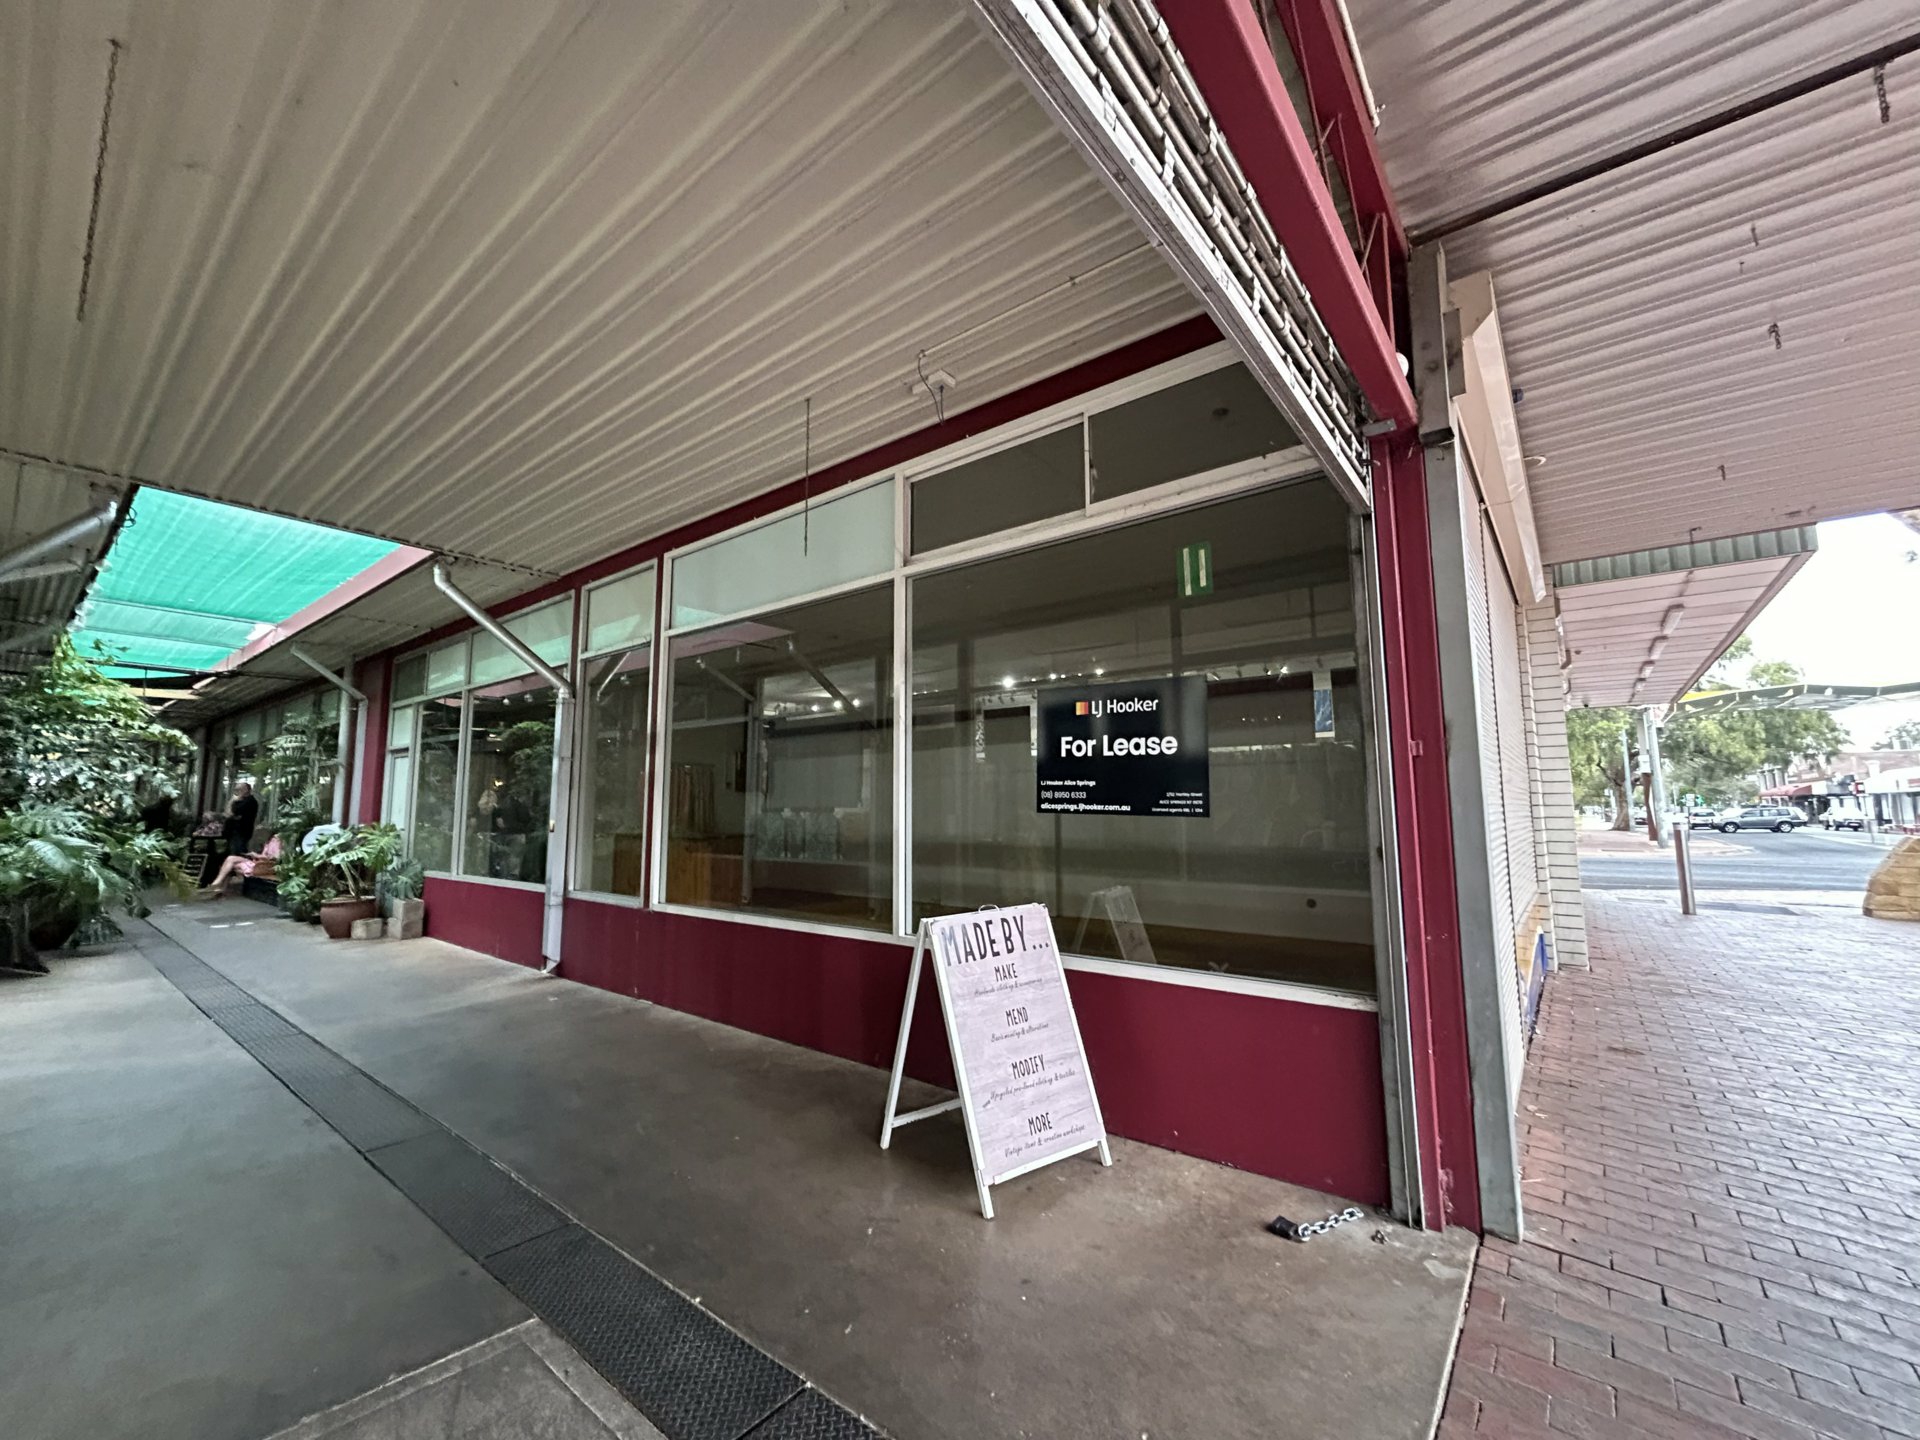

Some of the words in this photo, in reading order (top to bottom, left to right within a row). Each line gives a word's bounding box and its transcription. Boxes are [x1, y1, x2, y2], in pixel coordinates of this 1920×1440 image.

[1091, 699, 1103, 718] LJ
[1106, 698, 1159, 714] Hooker
[1060, 736, 1097, 757] For
[1102, 735, 1178, 756] Lease
[1071, 791, 1086, 799] 6333
[1040, 802, 1131, 812] alicesprings.ljhooker.com.au
[942, 920, 1000, 966] MADE
[994, 963, 1018, 982] MAKE
[1006, 1006, 1029, 1027] MEND
[1012, 1054, 1045, 1080] MODIFY
[1028, 1112, 1053, 1136] MORE
[1038, 1137, 1042, 1146] &
